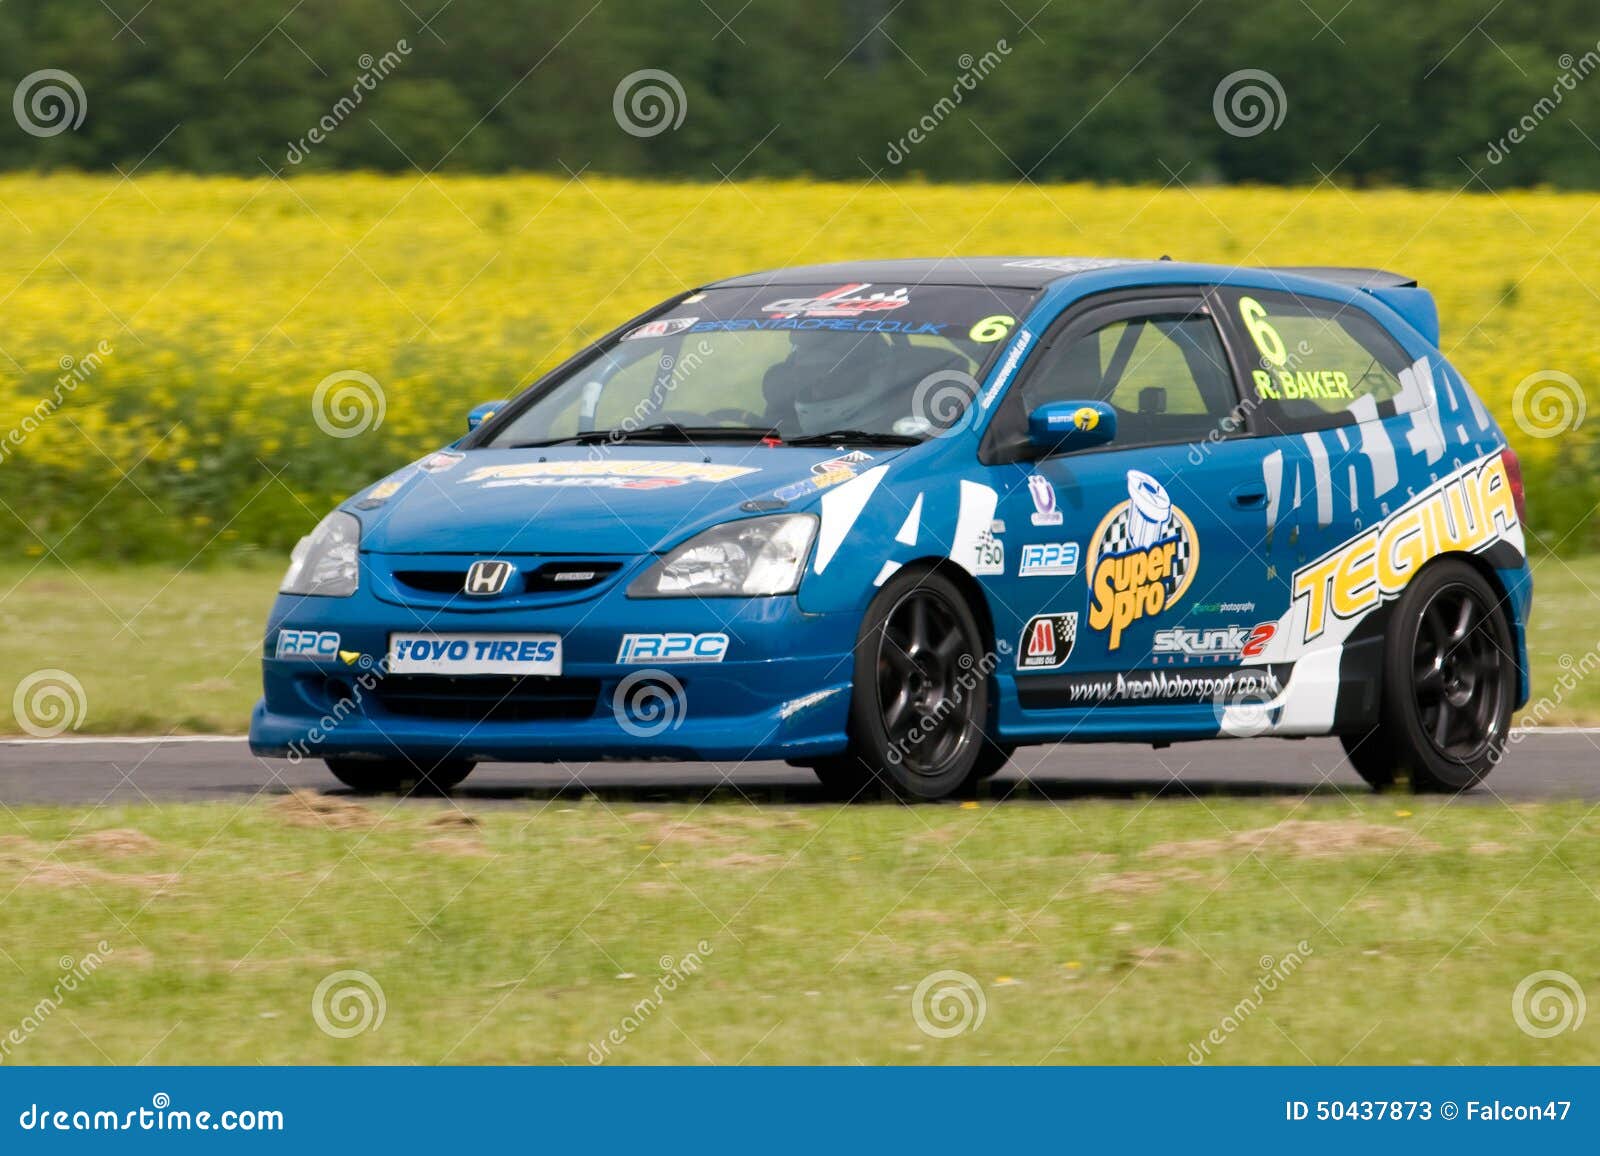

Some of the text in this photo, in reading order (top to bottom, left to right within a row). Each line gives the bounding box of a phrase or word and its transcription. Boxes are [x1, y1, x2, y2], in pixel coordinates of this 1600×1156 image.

[969, 315, 1015, 343] 6
[1239, 296, 1287, 366] 6
[1252, 370, 1354, 399] R. BAKER
[1294, 453, 1520, 642] TEGIWA
[396, 639, 557, 662] TOYO TIRES
